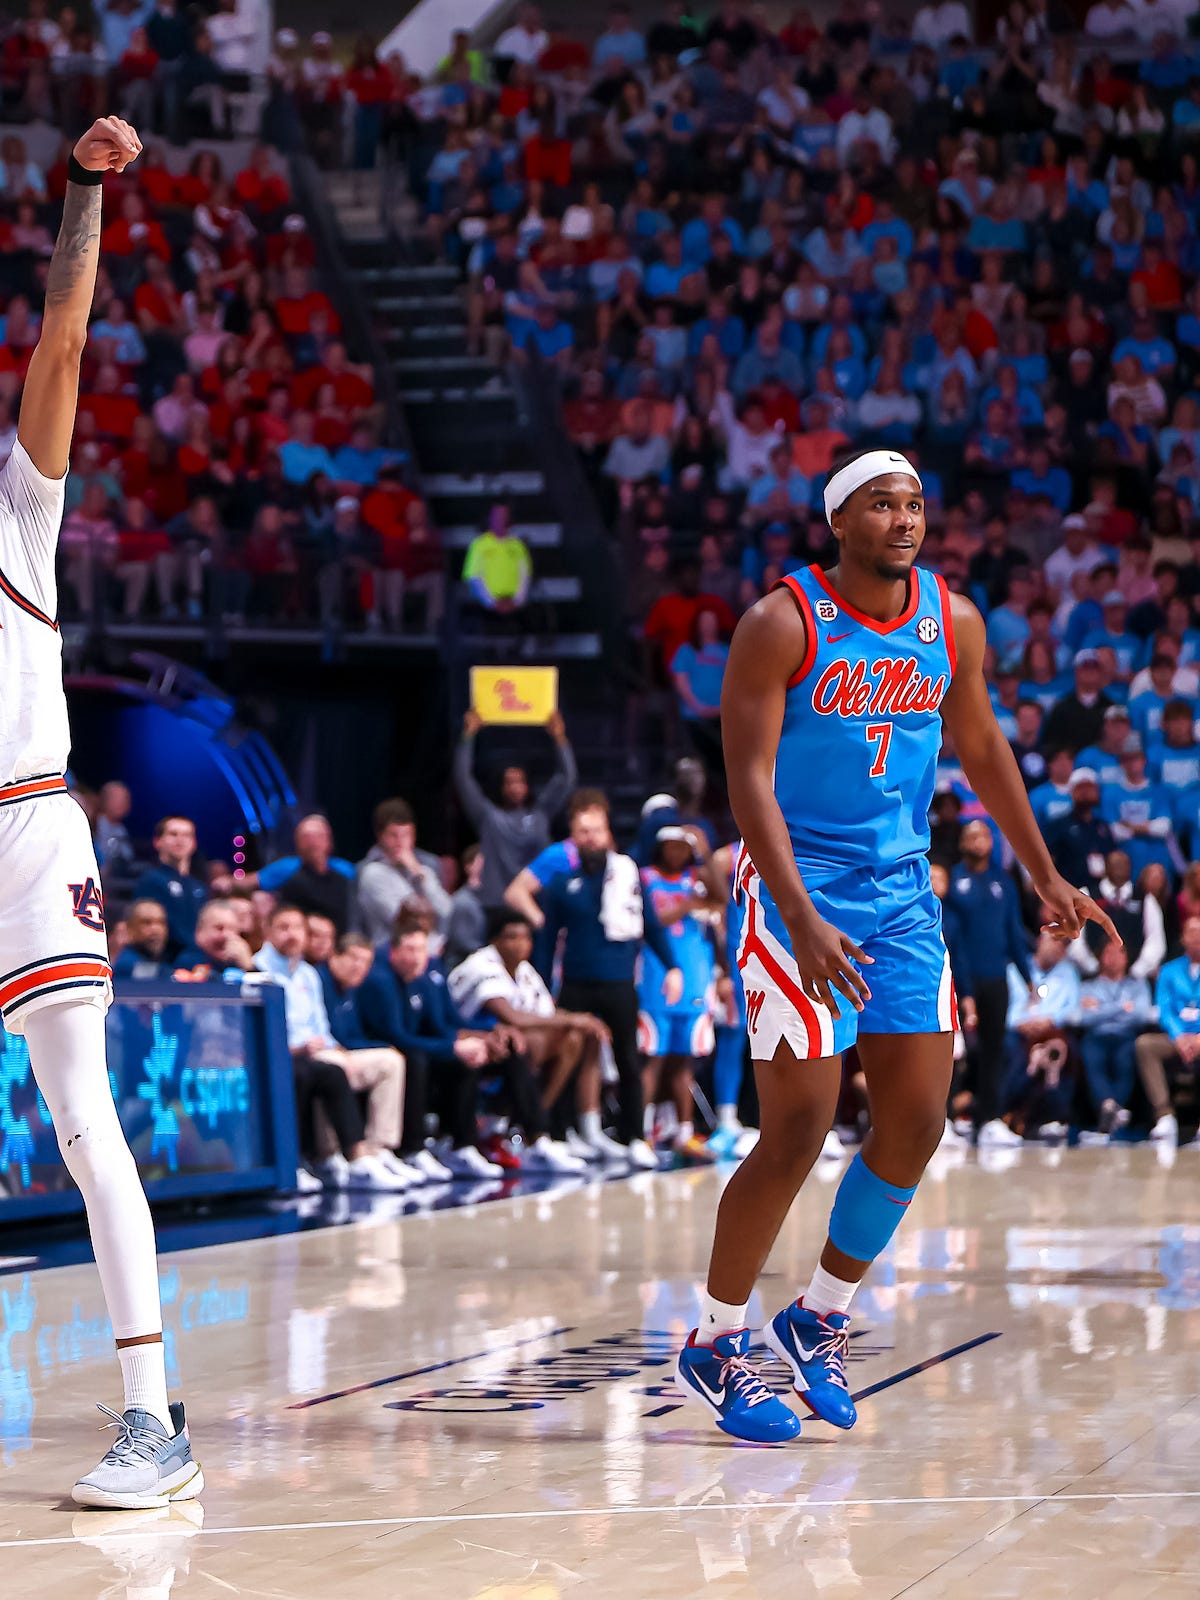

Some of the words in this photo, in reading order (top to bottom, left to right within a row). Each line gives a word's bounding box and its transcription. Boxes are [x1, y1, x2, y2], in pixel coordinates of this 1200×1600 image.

[819, 606, 835, 618] 22
[917, 616, 939, 644] SEC
[812, 658, 872, 718] Ole
[868, 656, 946, 716] Miss
[865, 721, 893, 778] 7
